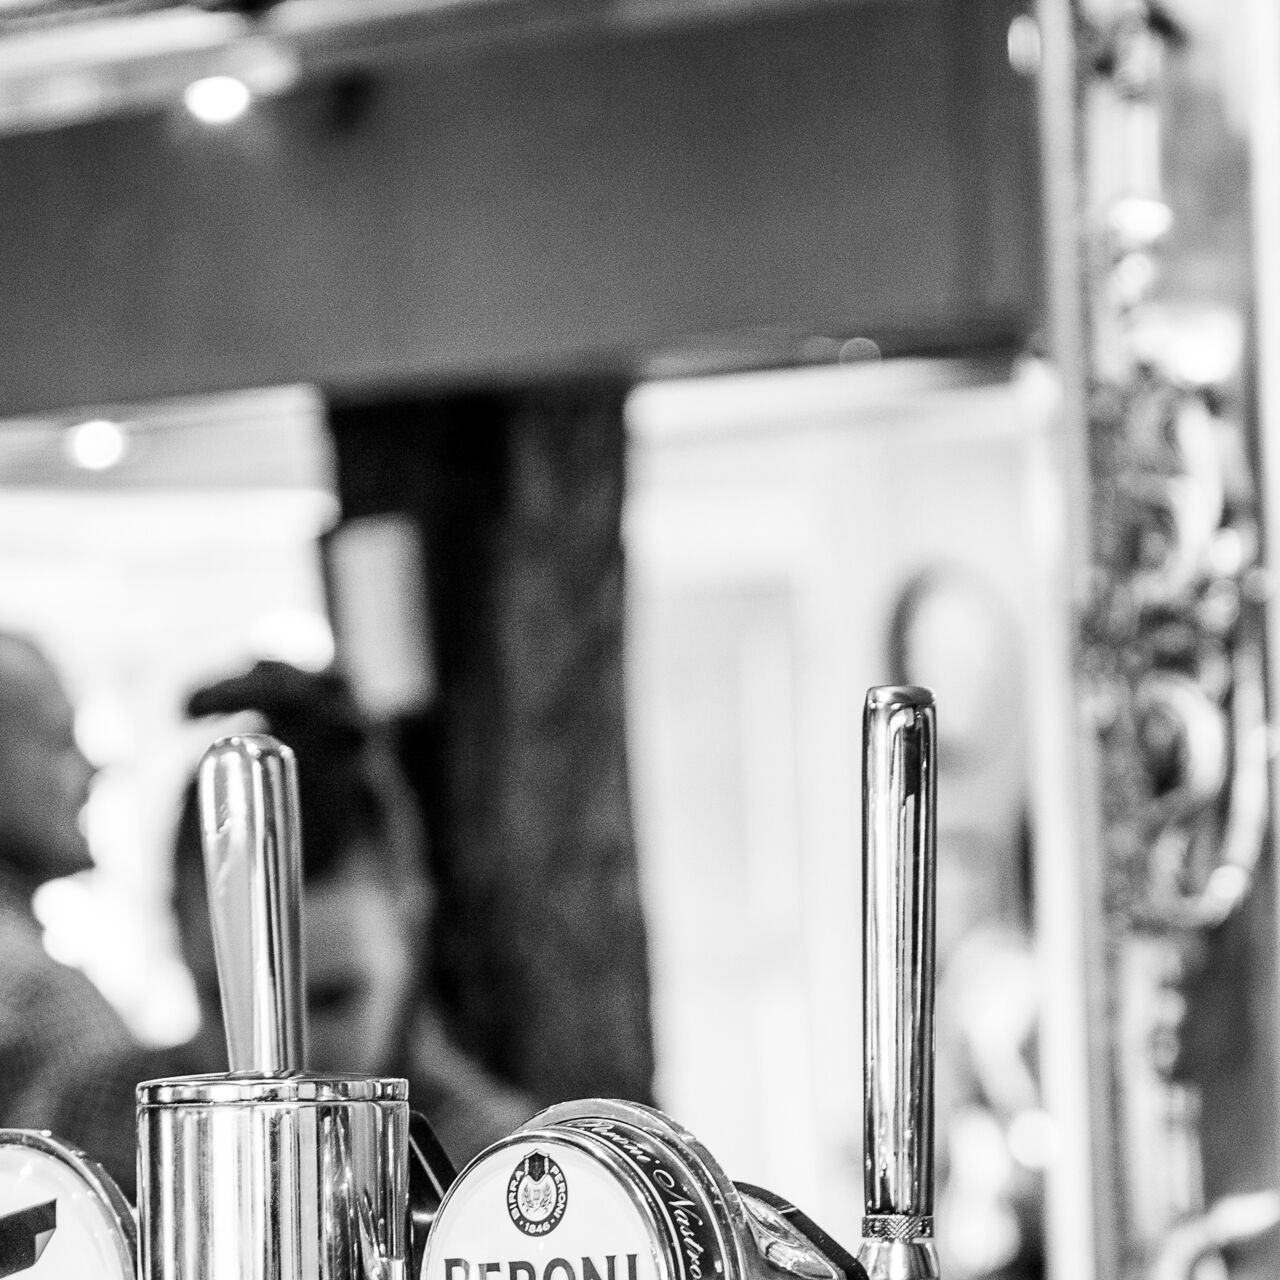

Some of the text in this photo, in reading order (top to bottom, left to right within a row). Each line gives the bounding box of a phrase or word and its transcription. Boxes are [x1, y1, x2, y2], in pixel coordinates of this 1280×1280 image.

[508, 1165, 567, 1220] BIRRA PERONI
[524, 1221, 551, 1234] 1846
